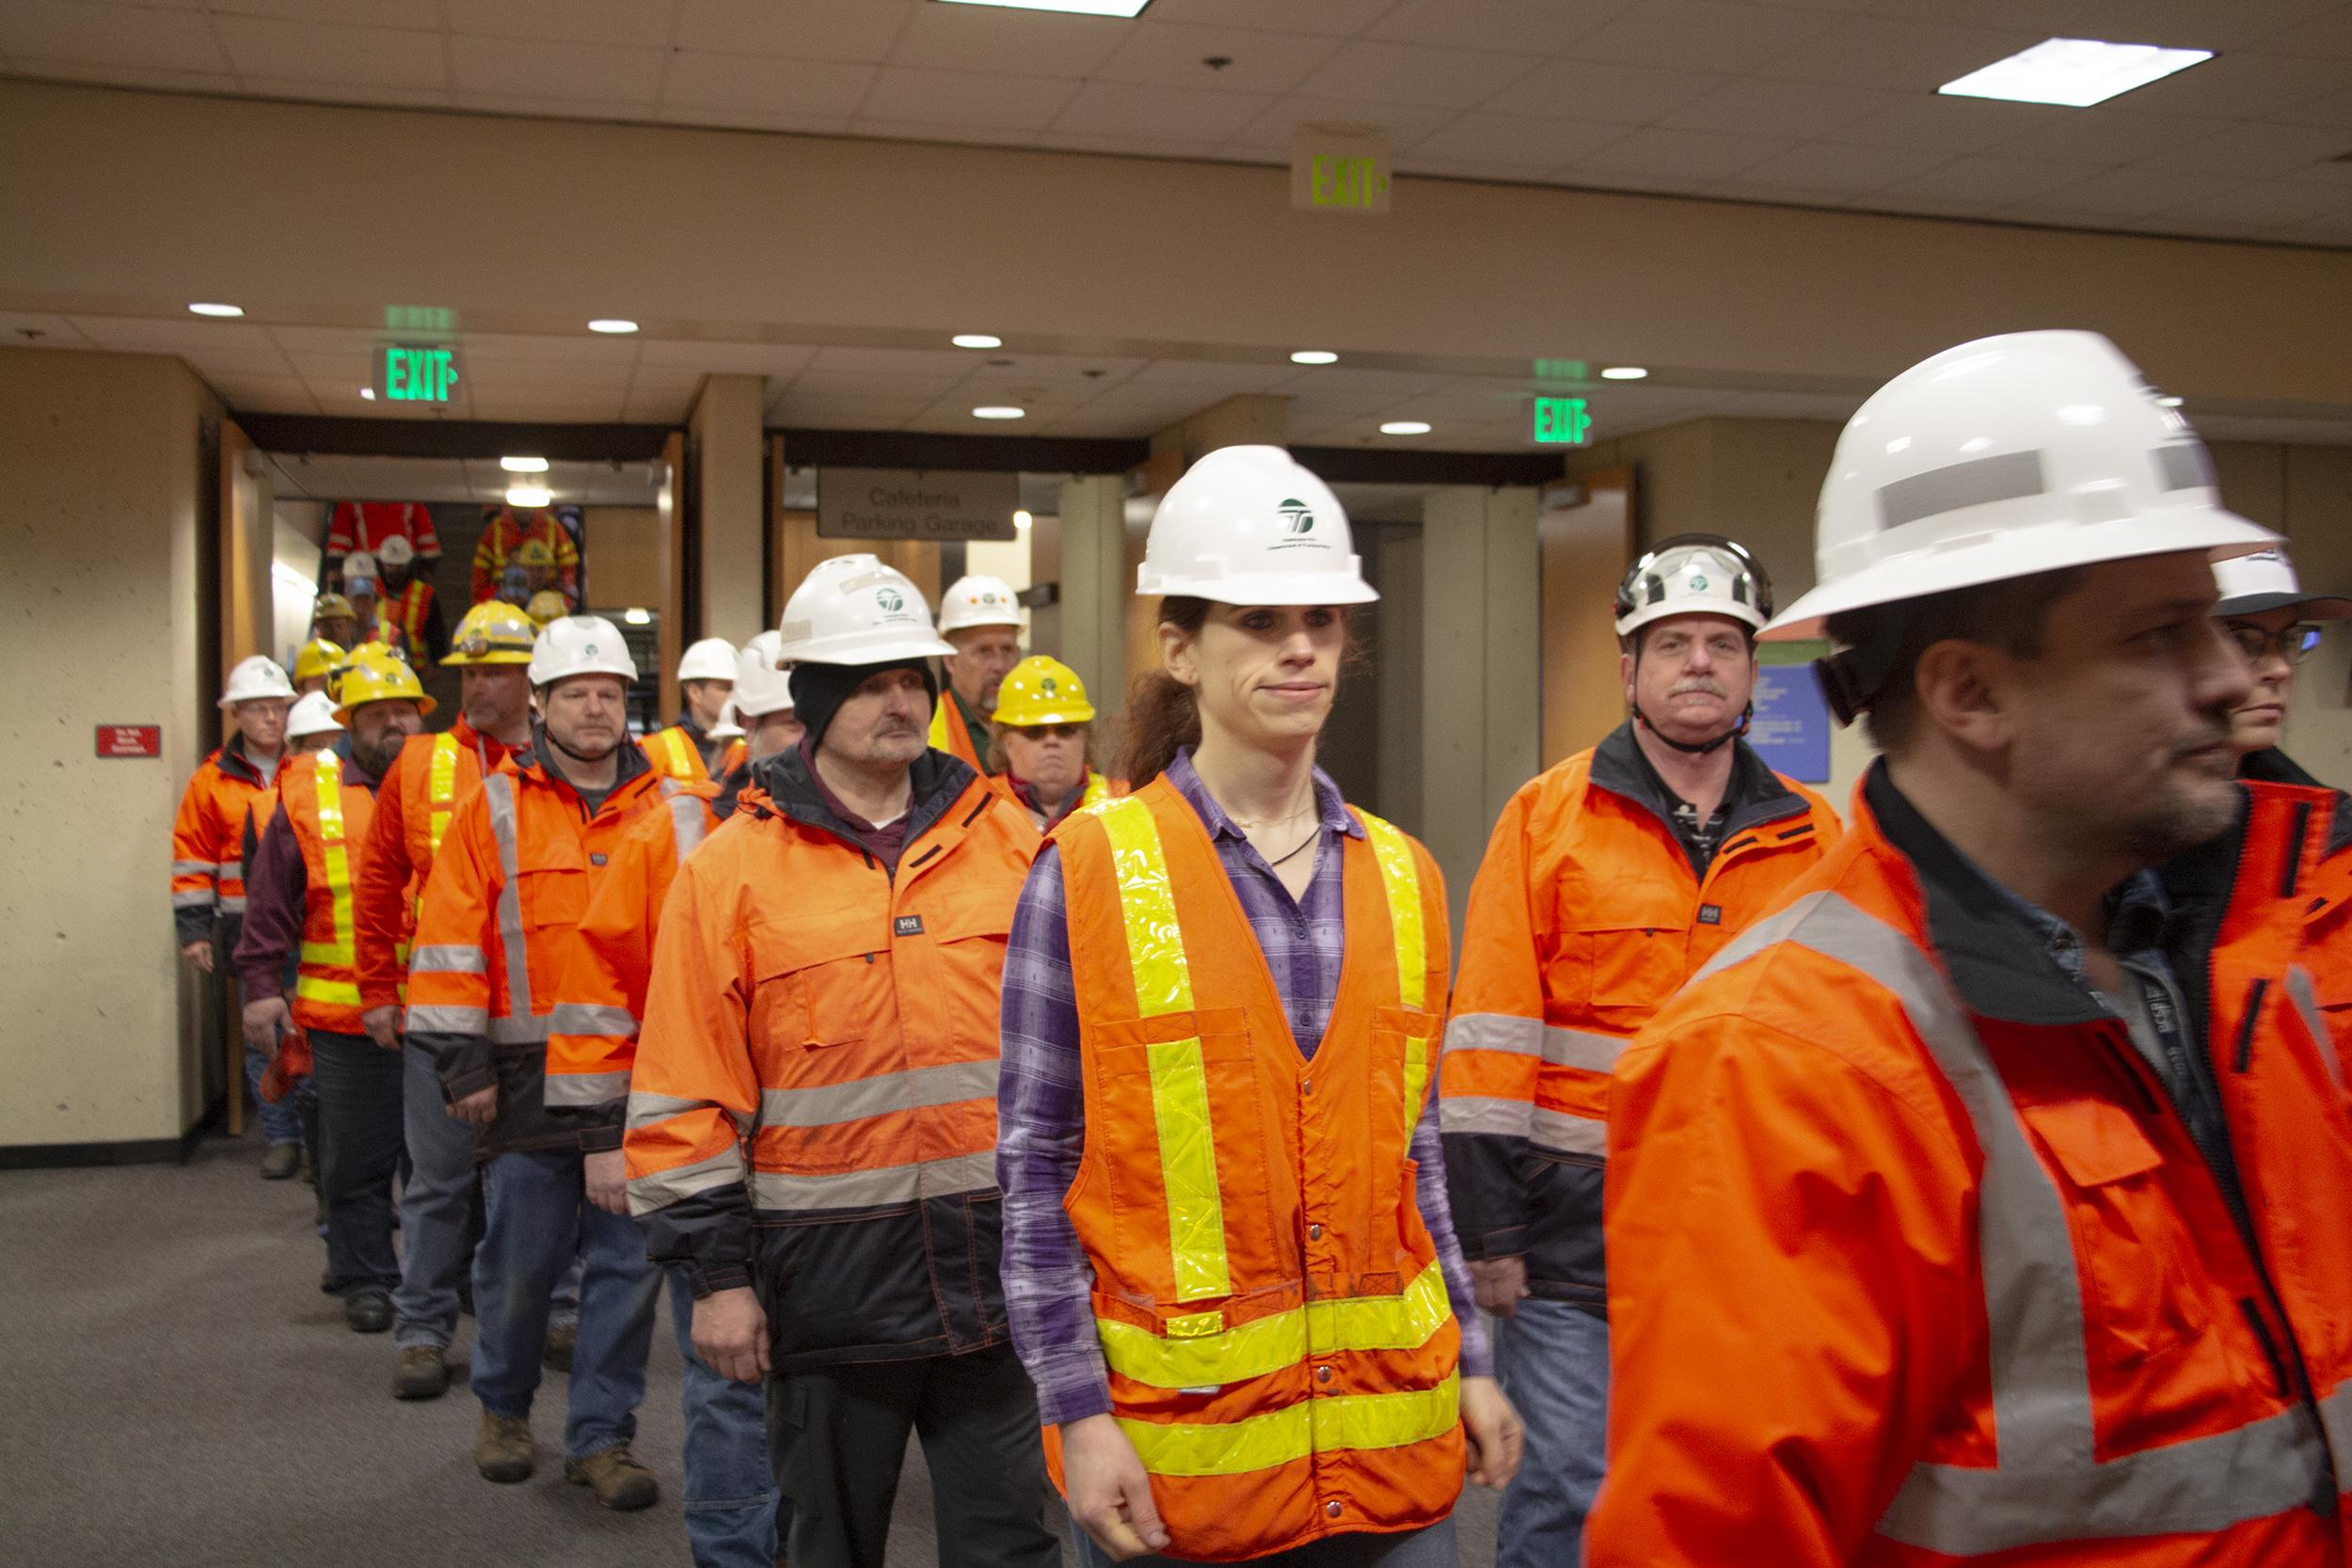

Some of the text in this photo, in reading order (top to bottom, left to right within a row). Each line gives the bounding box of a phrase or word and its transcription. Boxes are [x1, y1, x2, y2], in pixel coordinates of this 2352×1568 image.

[1312, 154, 1375, 206] EXIT
[387, 348, 452, 401] EXIT
[1534, 397, 1586, 443] EXIT
[869, 486, 961, 508] Cafeteria
[841, 510, 998, 535] Parking Garage
